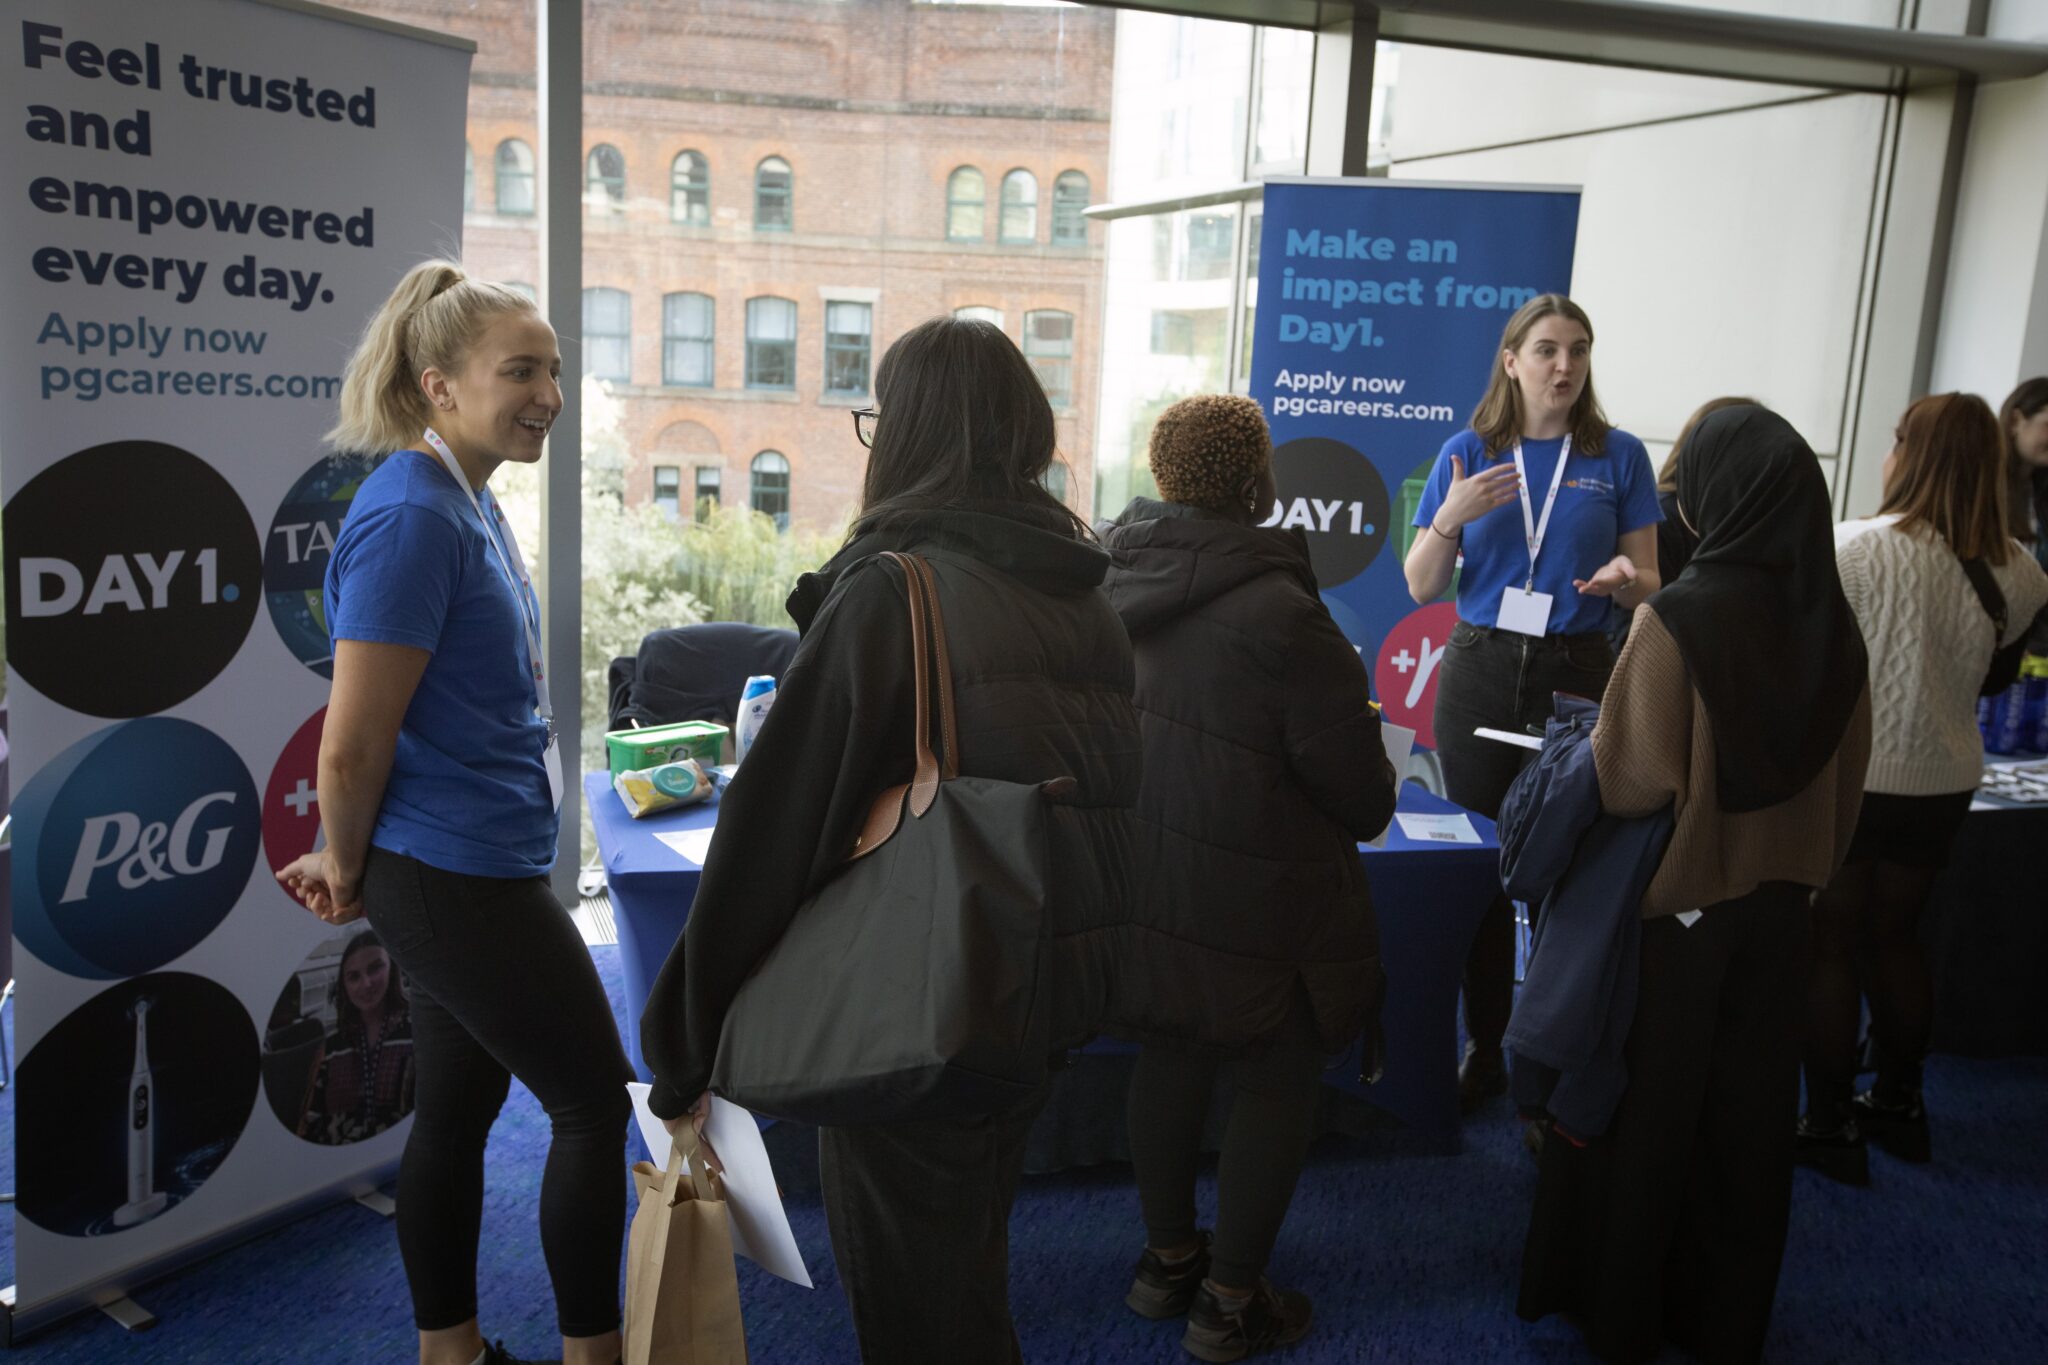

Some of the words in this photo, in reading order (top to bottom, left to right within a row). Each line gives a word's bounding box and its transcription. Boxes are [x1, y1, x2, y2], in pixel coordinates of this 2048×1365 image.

[22, 20, 161, 91] Feel
[179, 53, 376, 129] trusted
[26, 104, 152, 157] and
[28, 176, 374, 248] empowered
[1285, 228, 1396, 261] Make
[1406, 238, 1458, 264] an
[32, 246, 208, 304] every
[223, 255, 335, 312] day.
[1282, 266, 1424, 310] impact
[1435, 276, 1538, 309] from
[37, 311, 173, 359] Apply
[184, 326, 267, 355] now
[1279, 313, 1385, 353] Day1.
[41, 364, 341, 402] pgcareers.com
[1274, 368, 1347, 396] Apply
[1351, 376, 1406, 394] now
[1273, 396, 1455, 422] pgcareers.com
[59, 791, 237, 904] P&G
